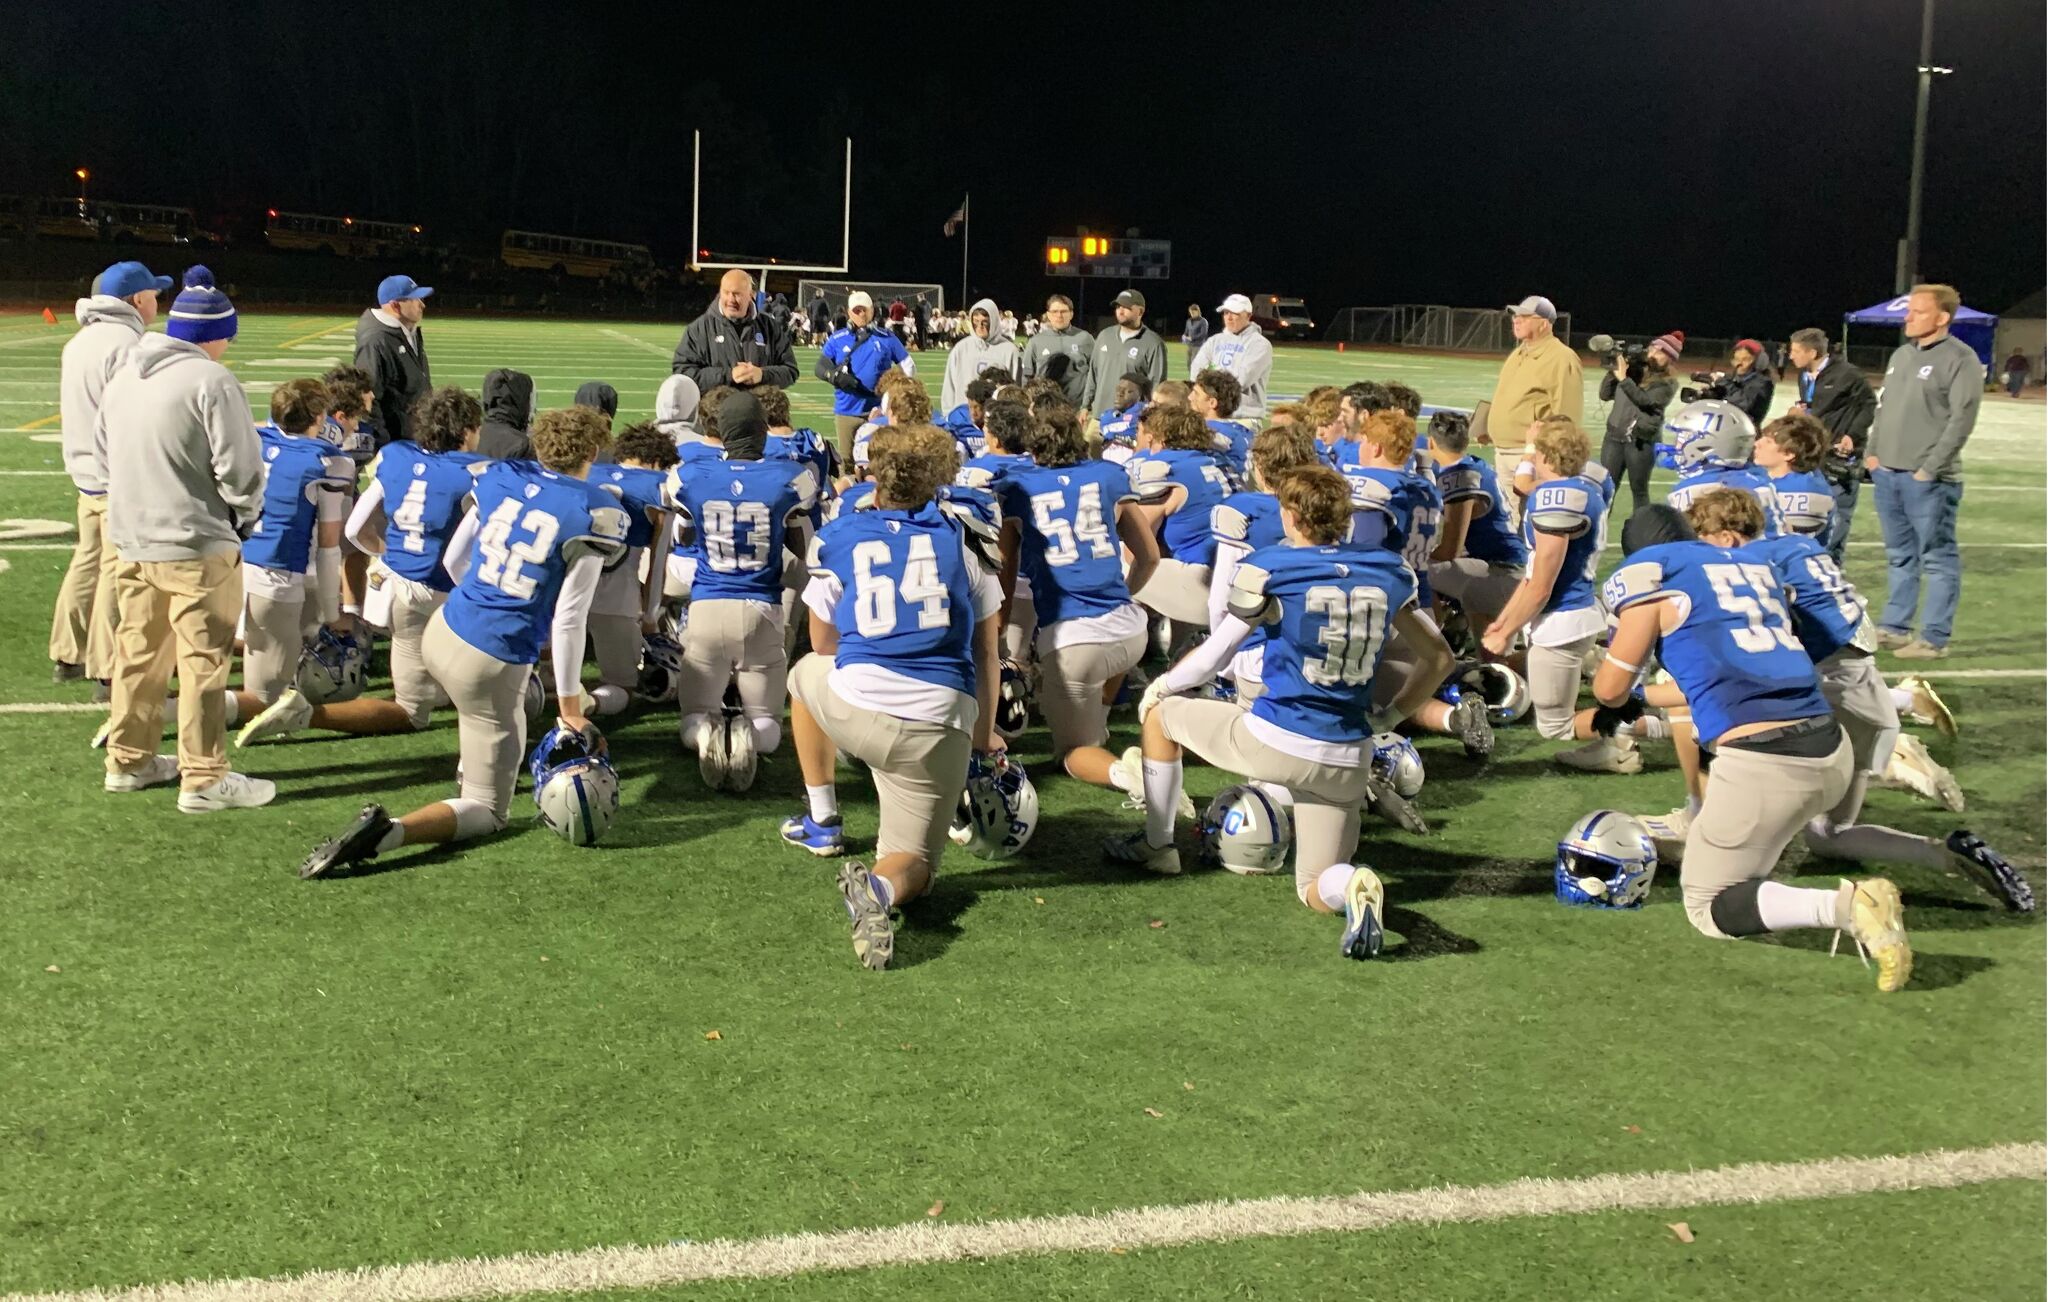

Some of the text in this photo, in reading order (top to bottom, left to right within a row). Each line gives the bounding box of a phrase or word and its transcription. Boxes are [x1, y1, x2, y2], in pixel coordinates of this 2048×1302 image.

[1222, 352, 1234, 367] G
[1918, 365, 1934, 377] G
[1702, 412, 1724, 432] 71
[1442, 473, 1461, 491] 57
[1542, 489, 1566, 506] 80
[393, 479, 428, 553] 4
[1674, 489, 1693, 512] 71
[1783, 494, 1809, 512] 72
[702, 500, 771, 573] 83
[1031, 482, 1116, 567] 54
[478, 496, 560, 600] 42
[851, 534, 950, 639] 64
[1605, 573, 1627, 605] 55
[1702, 562, 1806, 653] 55
[1302, 585, 1389, 687] 30
